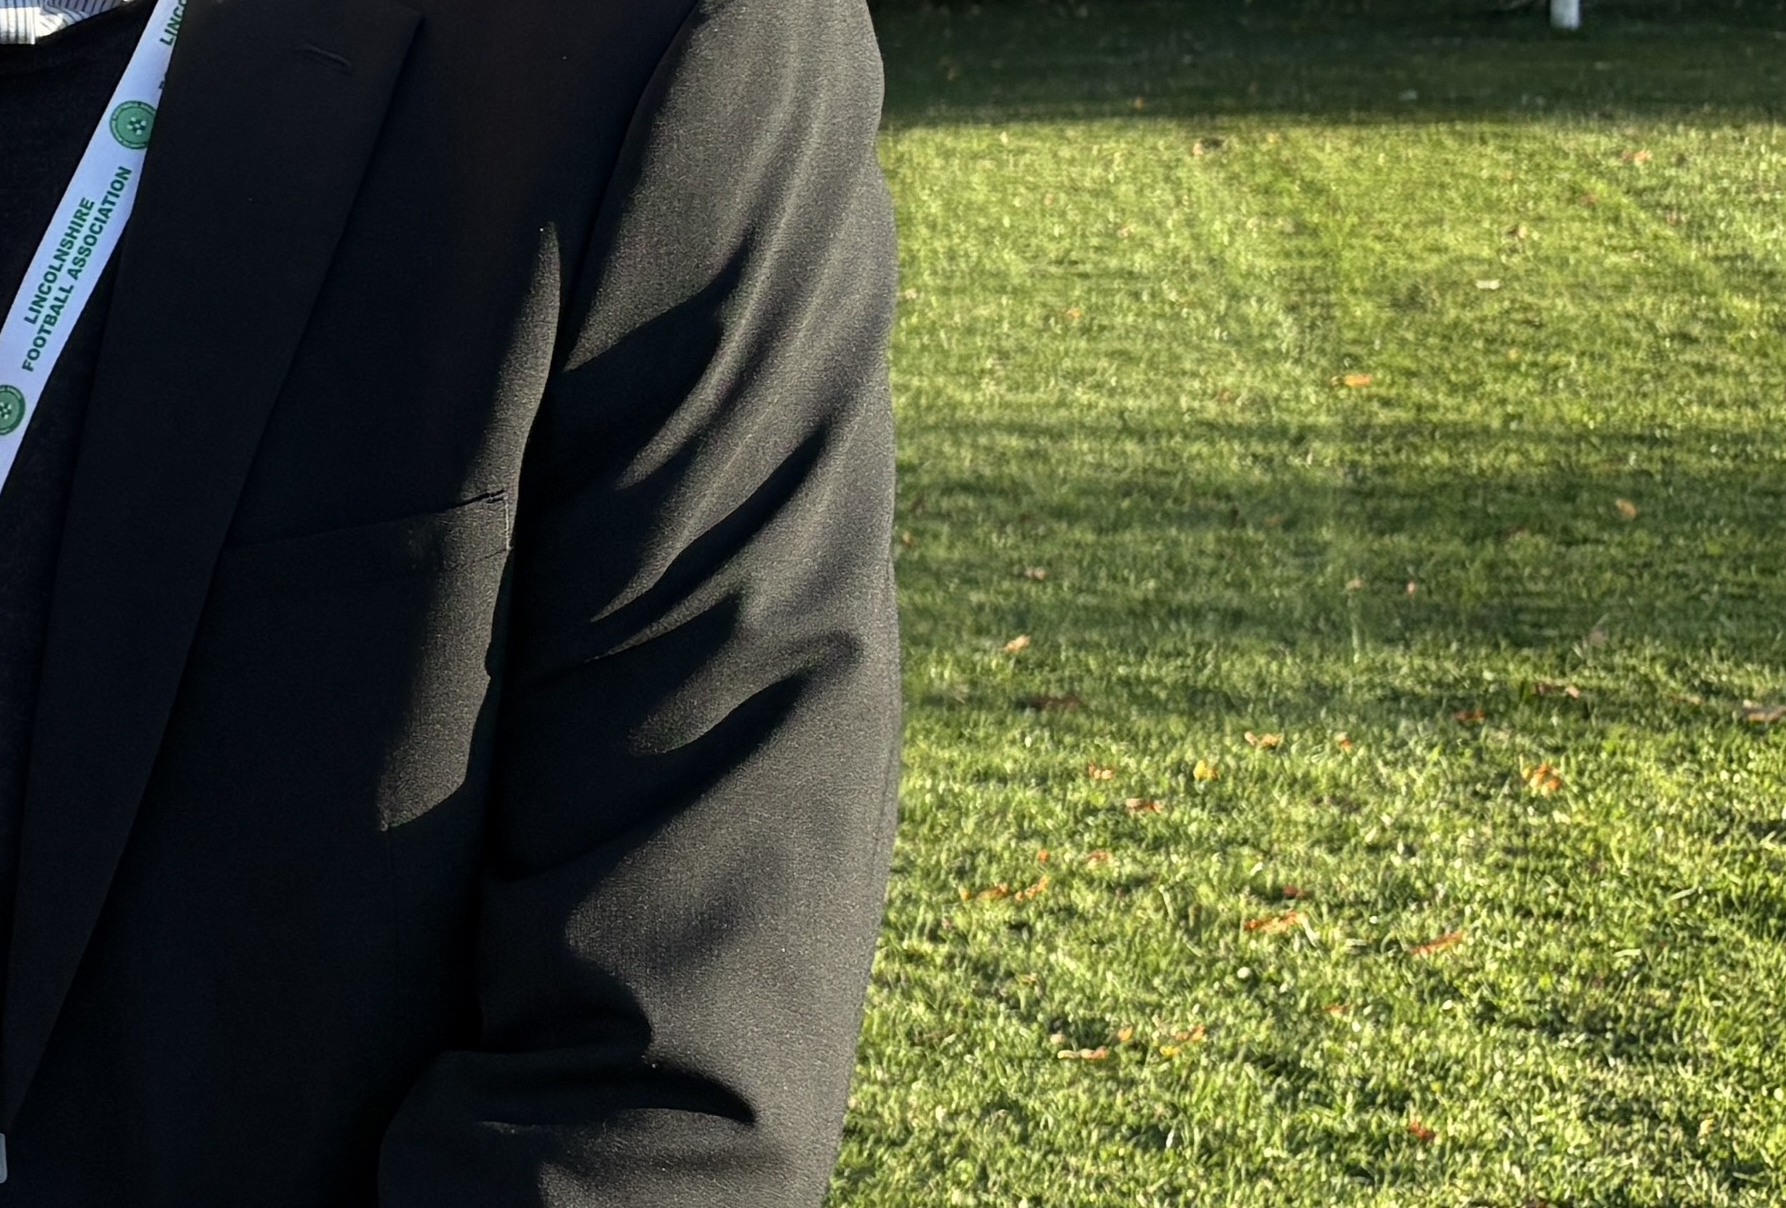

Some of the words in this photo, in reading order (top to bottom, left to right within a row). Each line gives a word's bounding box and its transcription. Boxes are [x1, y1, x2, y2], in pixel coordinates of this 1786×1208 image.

[22, 285, 74, 372] FOOTBALL
[67, 166, 132, 280] ASSOCIATION
[24, 197, 95, 325] LINCOLNSHIRE
